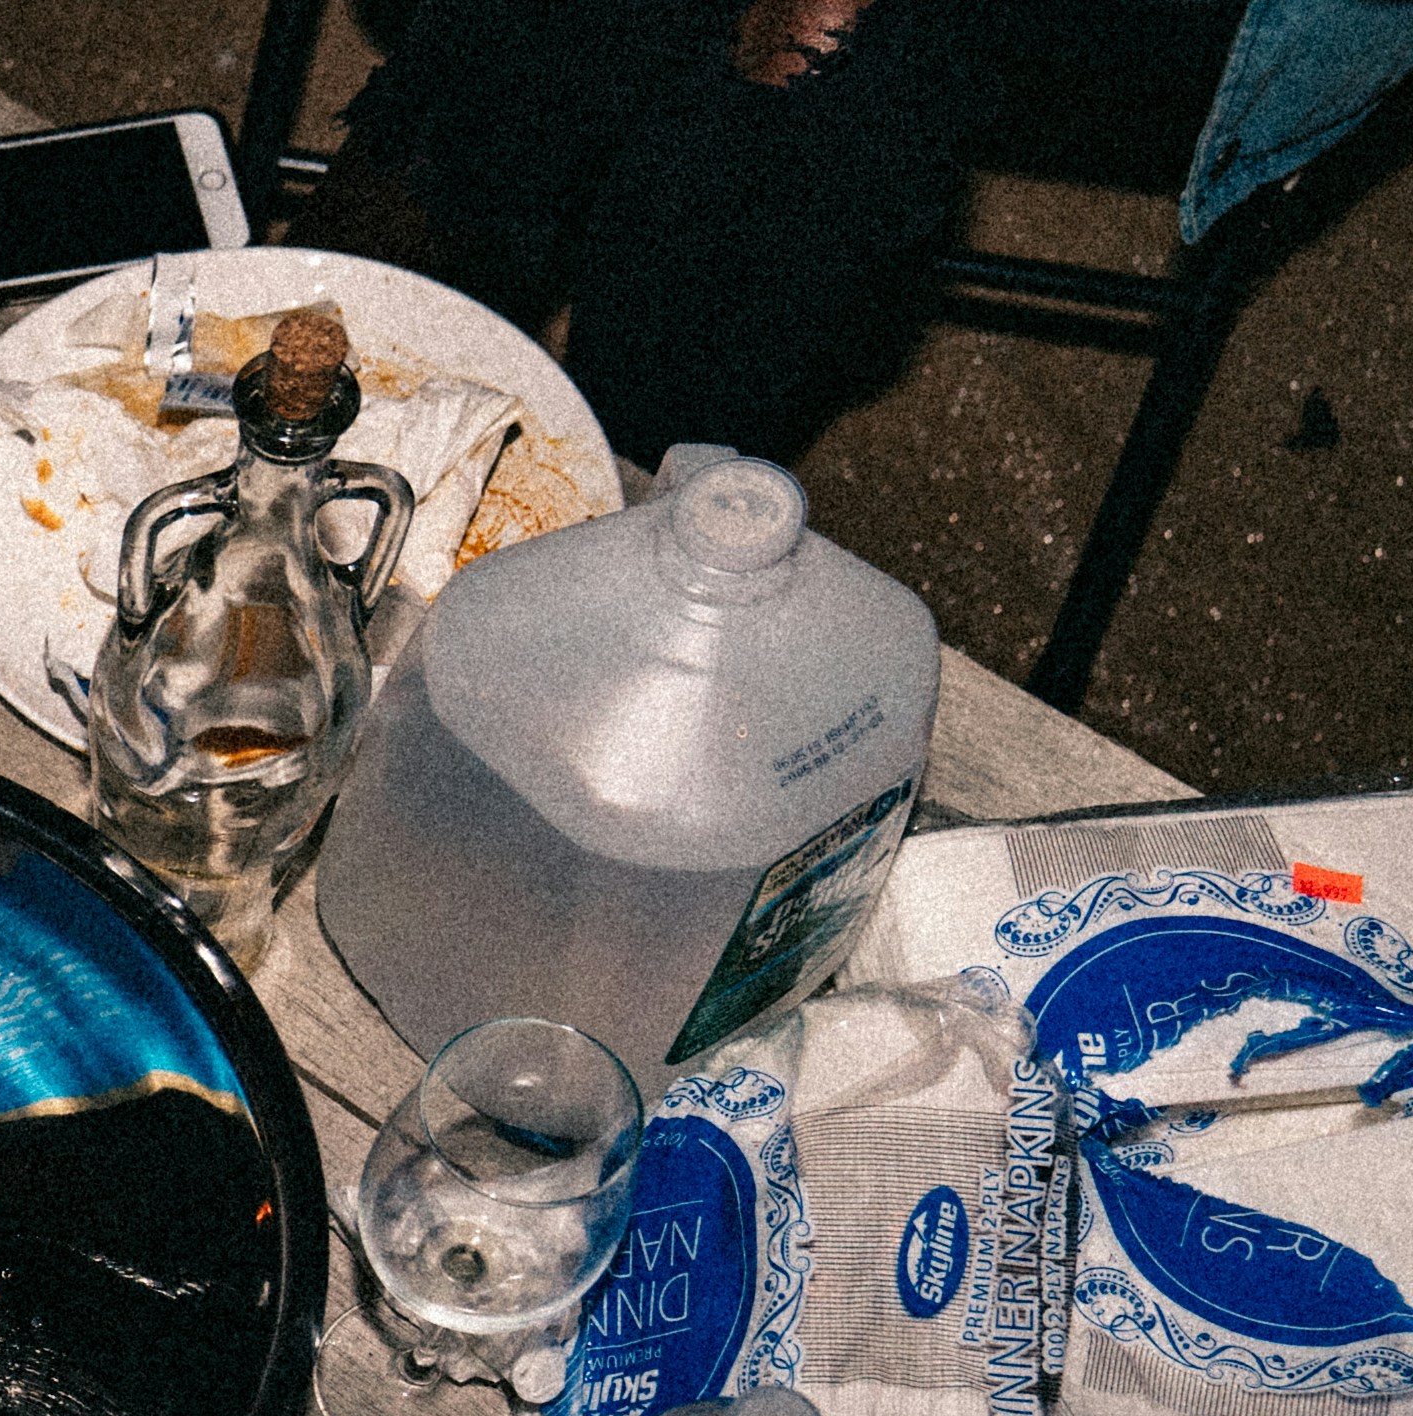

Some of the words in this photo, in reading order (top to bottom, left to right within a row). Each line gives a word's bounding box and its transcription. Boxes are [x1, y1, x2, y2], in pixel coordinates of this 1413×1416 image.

[920, 1199, 959, 1304] Skyline
[962, 1237, 996, 1342] PREMIUM
[982, 1167, 1000, 1227] 2-PLY
[1047, 1159, 1070, 1255] NAPKINS
[1048, 1331, 1066, 1370] 100
